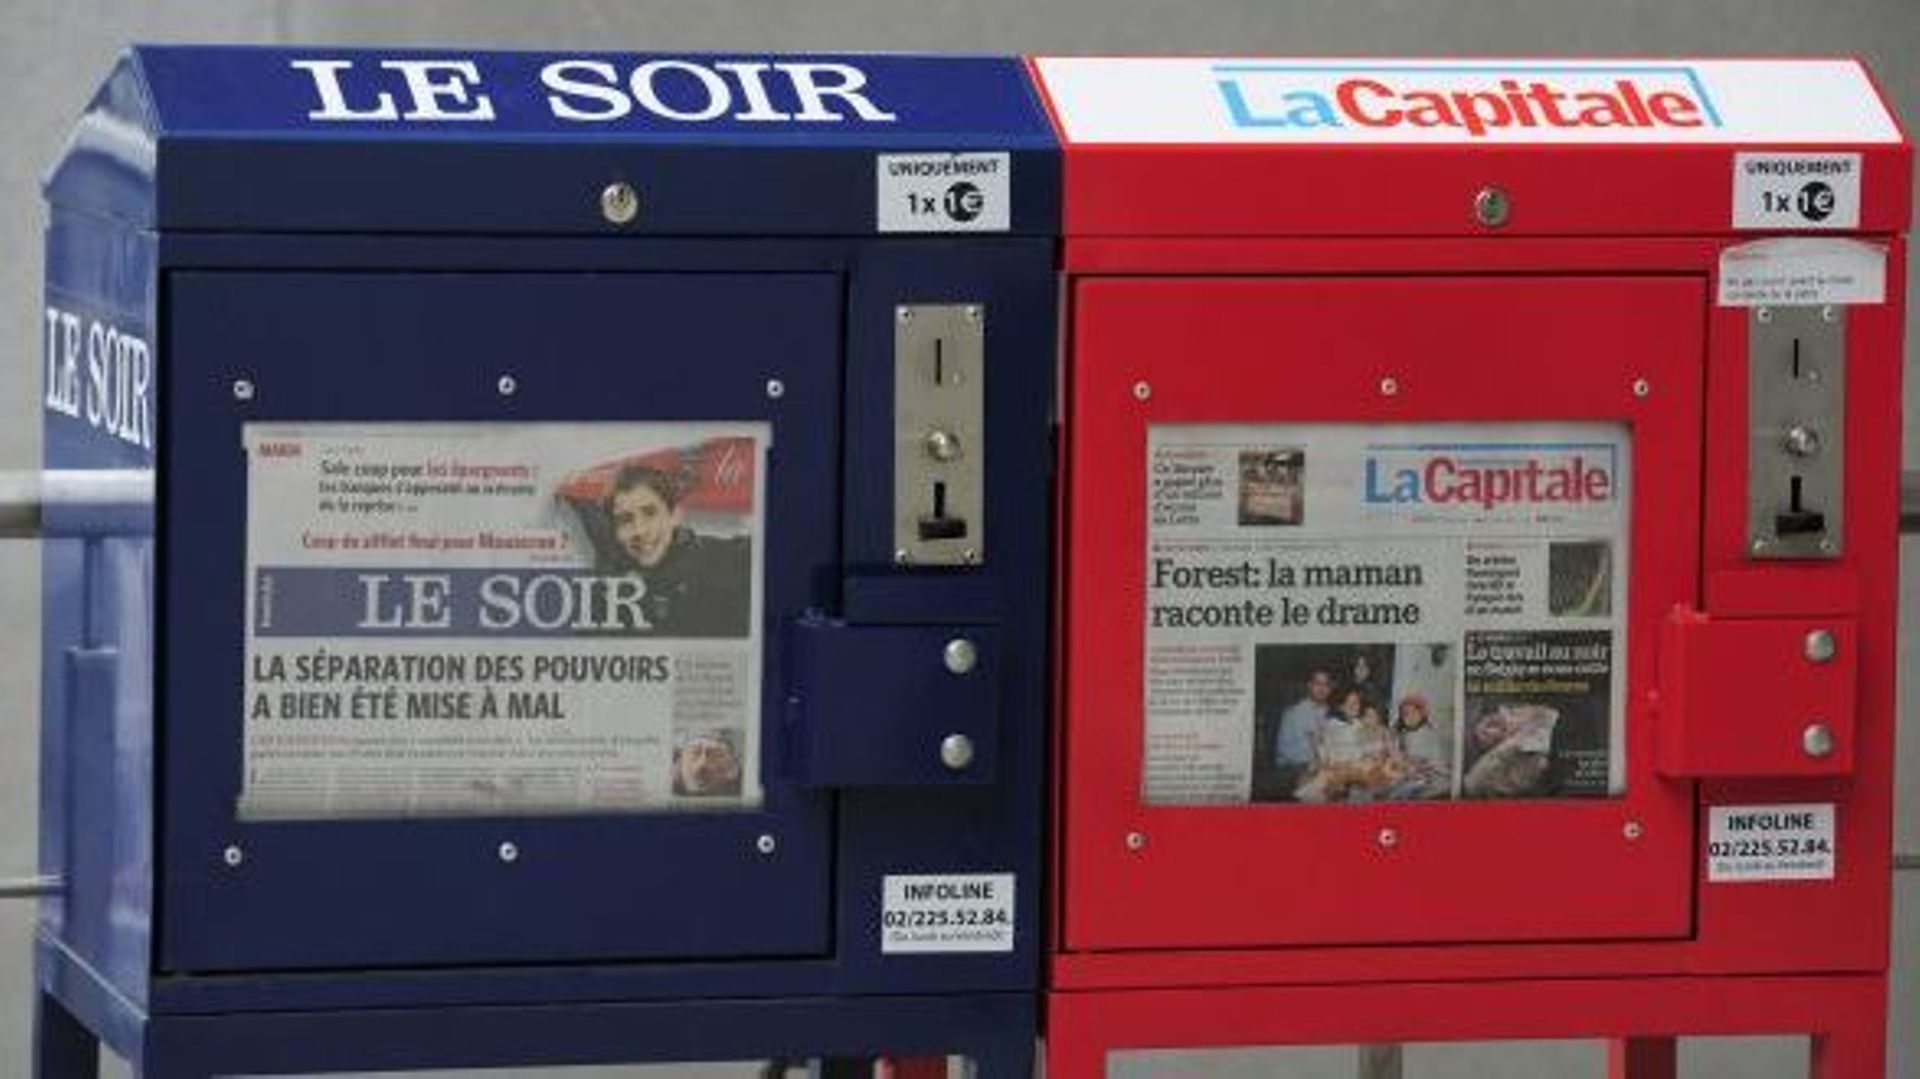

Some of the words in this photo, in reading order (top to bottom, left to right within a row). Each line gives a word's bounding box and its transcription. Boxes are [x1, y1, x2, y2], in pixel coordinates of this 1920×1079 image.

[291, 59, 496, 121] LE
[540, 60, 896, 121] SOIR
[888, 159, 1000, 176] UNIQUEMENT
[1746, 159, 1850, 175] UNIQUEMENT
[46, 307, 81, 418] LE
[87, 321, 151, 449] SOIR
[1153, 558, 1260, 589] Forest:
[1268, 557, 1295, 588] la
[1304, 563, 1424, 587] maman
[357, 574, 450, 628] LE
[479, 574, 652, 629] SOIR
[1152, 600, 1273, 628] raconte
[1281, 597, 1310, 626] le
[1316, 597, 1421, 626] drame
[253, 655, 286, 683] LA
[295, 648, 466, 683] SÉPARATION
[475, 655, 523, 683] DES
[534, 655, 669, 683] POUVOIRS
[251, 692, 271, 719] A
[280, 692, 341, 719] BIEN
[350, 686, 398, 719] ÉTÉ
[406, 691, 471, 719] MISE
[479, 686, 499, 719] À
[508, 692, 565, 719] MAL
[1728, 813, 1813, 831] INFOLINE
[904, 882, 993, 900] INFOLINE
